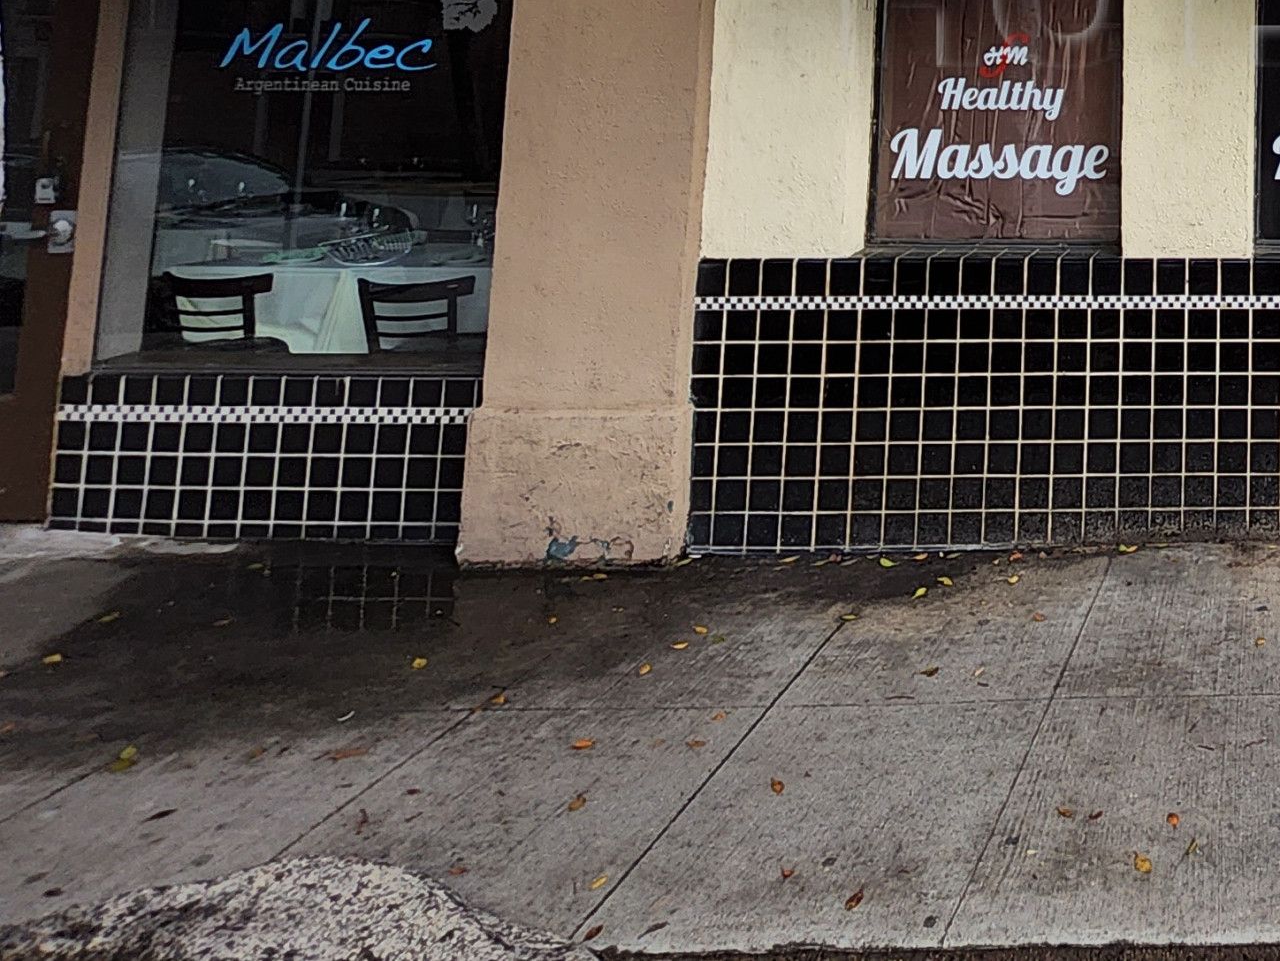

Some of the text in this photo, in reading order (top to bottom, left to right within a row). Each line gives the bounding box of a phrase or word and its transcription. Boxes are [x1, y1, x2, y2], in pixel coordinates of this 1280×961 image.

[219, 18, 437, 71] Malbec
[235, 77, 411, 94] Argentinean Cuisine
[938, 77, 1064, 120] Healthy
[890, 128, 1109, 196] Massage
